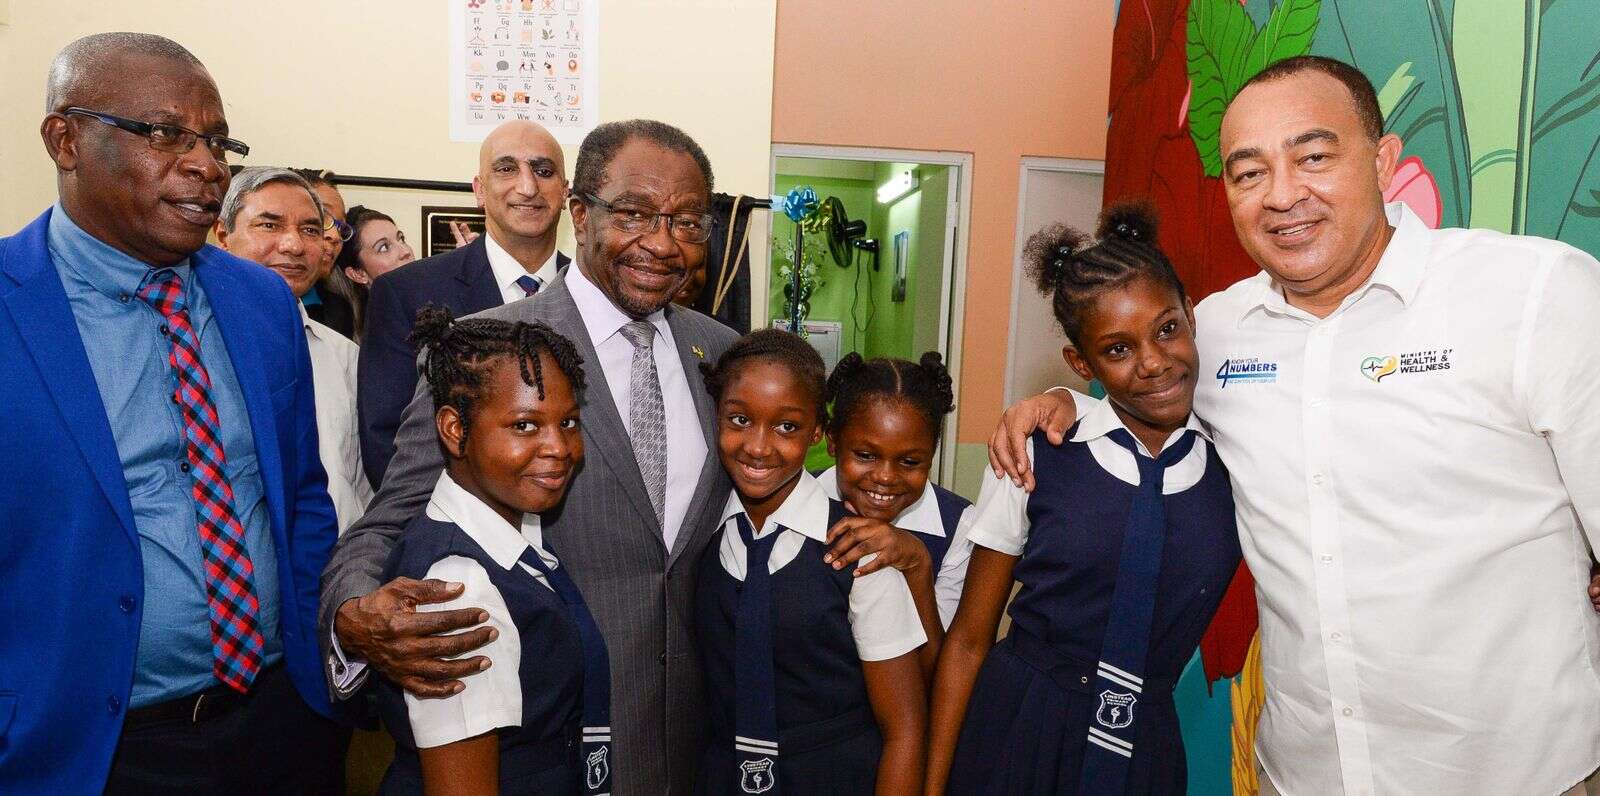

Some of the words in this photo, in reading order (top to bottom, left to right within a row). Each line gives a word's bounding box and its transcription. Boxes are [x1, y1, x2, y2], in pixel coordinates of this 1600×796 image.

[554, 114, 563, 123] Yy
[1401, 350, 1437, 358] MINISTRY
[1400, 356, 1437, 366] HEALTH
[1230, 363, 1277, 373] NUMBERS
[1400, 362, 1450, 373] WELLNESS
[1216, 359, 1230, 389] 4
